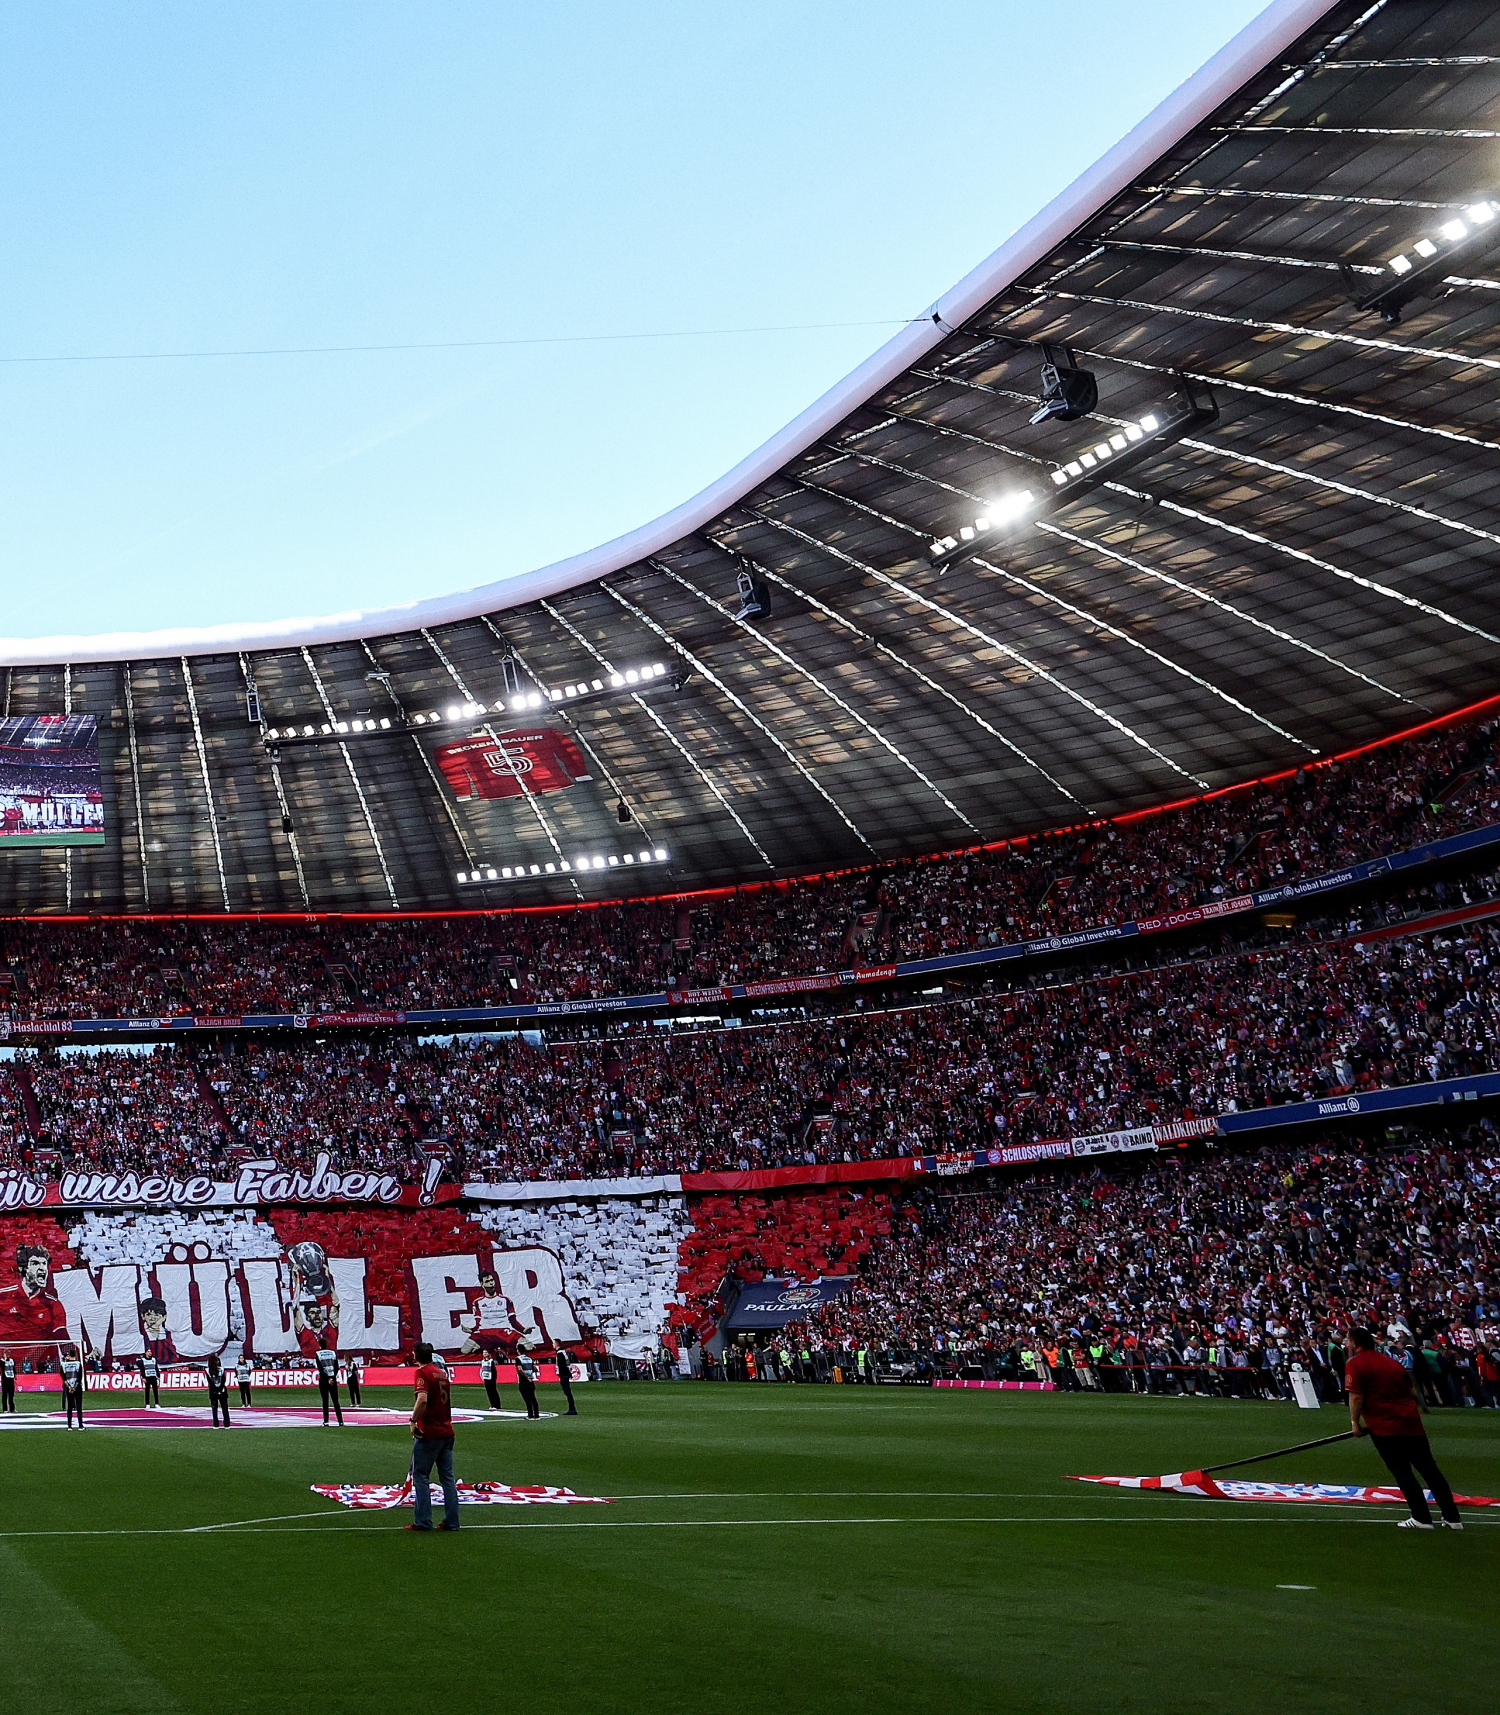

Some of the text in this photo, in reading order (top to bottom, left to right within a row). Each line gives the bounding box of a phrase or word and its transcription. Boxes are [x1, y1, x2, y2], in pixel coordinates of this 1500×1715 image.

[482, 747, 534, 776] 5
[1319, 872, 1353, 888] Investors
[1137, 910, 1202, 932] RED DOCS
[1061, 934, 1086, 946] Global
[1087, 927, 1122, 941] Investors
[571, 1003, 594, 1011] Global
[594, 1000, 627, 1009] Investors
[12, 1020, 73, 1033] Haslachtal 83
[128, 1020, 150, 1028] Allianz
[1318, 1102, 1348, 1114] Allianz
[1002, 1142, 1072, 1162] SCHLOSSPANTHER
[60, 1169, 216, 1205] unsere
[234, 1151, 402, 1204] Farben
[50, 1241, 584, 1362] MÜLLER
[112, 1371, 209, 1388] GRALIEREN
